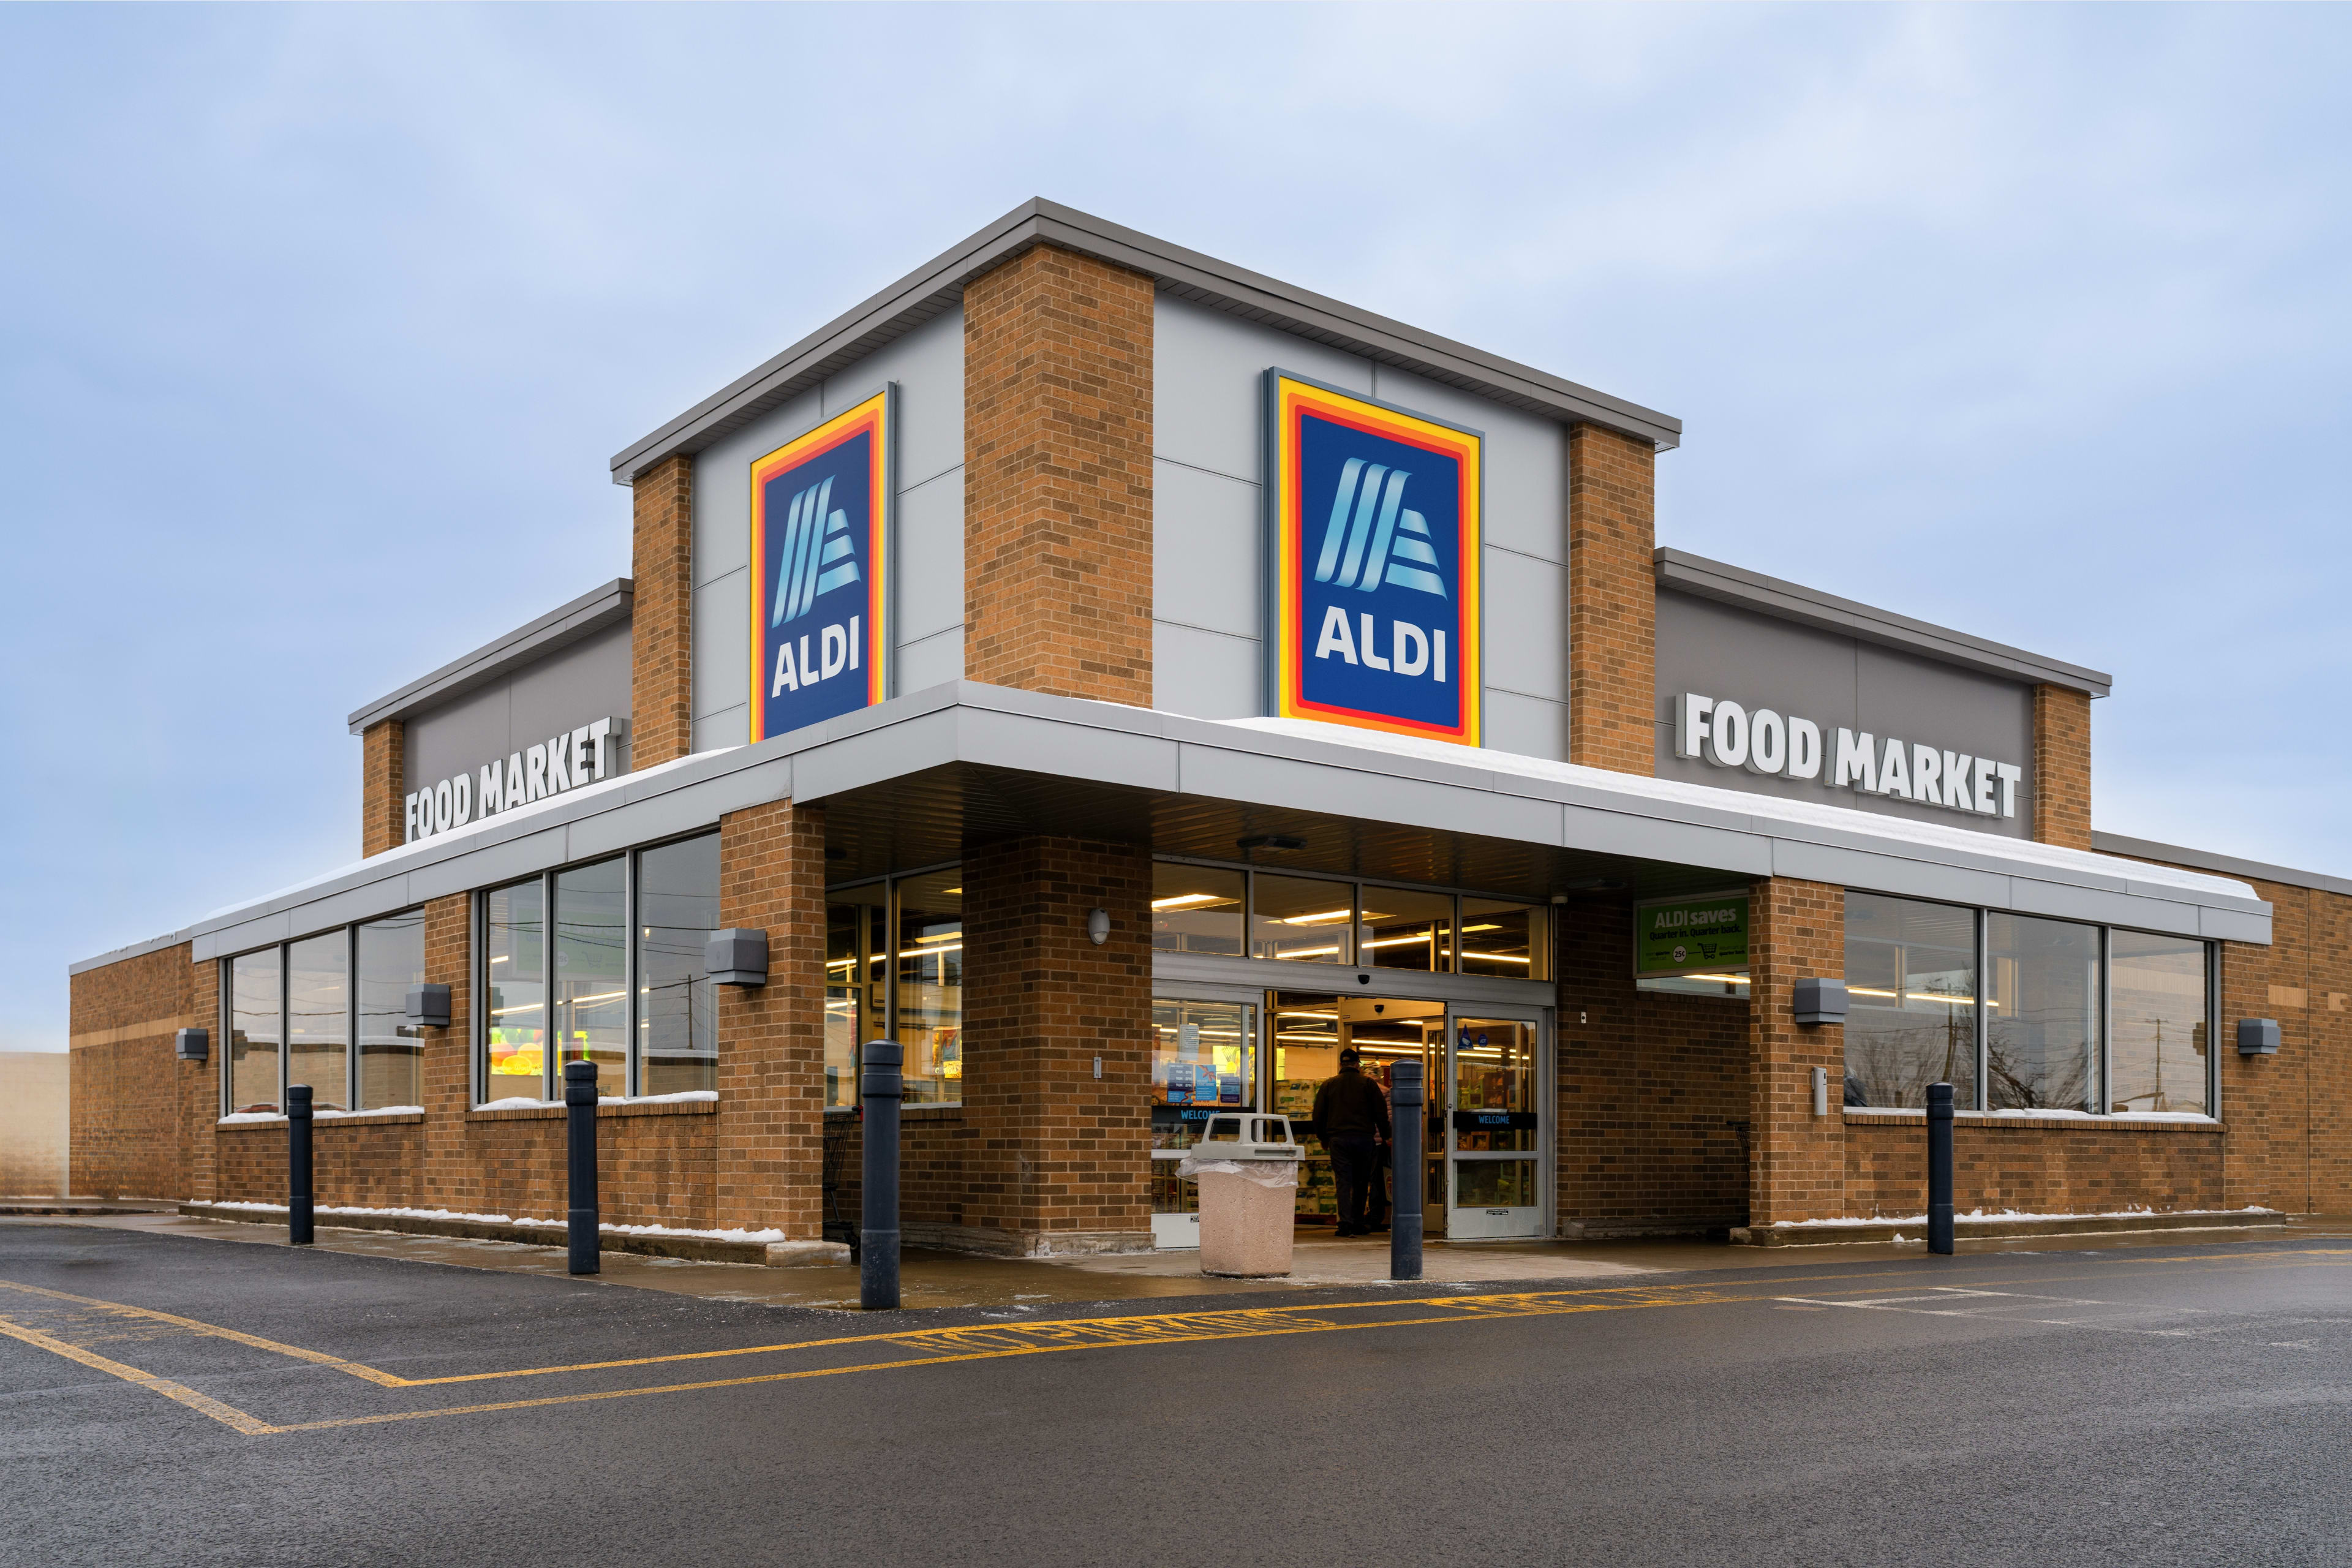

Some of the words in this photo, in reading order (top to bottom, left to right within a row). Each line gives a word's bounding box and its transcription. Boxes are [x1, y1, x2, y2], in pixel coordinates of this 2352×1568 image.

[772, 614, 859, 698] ALDI
[1315, 605, 1446, 682] ALDI
[405, 772, 473, 844] FOOD
[478, 715, 612, 819] MARKET
[1677, 692, 1821, 779] FOOD
[1826, 726, 2021, 818] MARKET
[1649, 930, 1678, 941] Quarter
[1679, 928, 1689, 938] in.
[1690, 927, 1719, 938] Quarter
[1721, 923, 1742, 934] back.
[1655, 910, 1687, 929] ALDI
[1690, 908, 1736, 925] saves
[1181, 1110, 1221, 1120] WELCO
[1479, 1115, 1510, 1124] WELCOME
